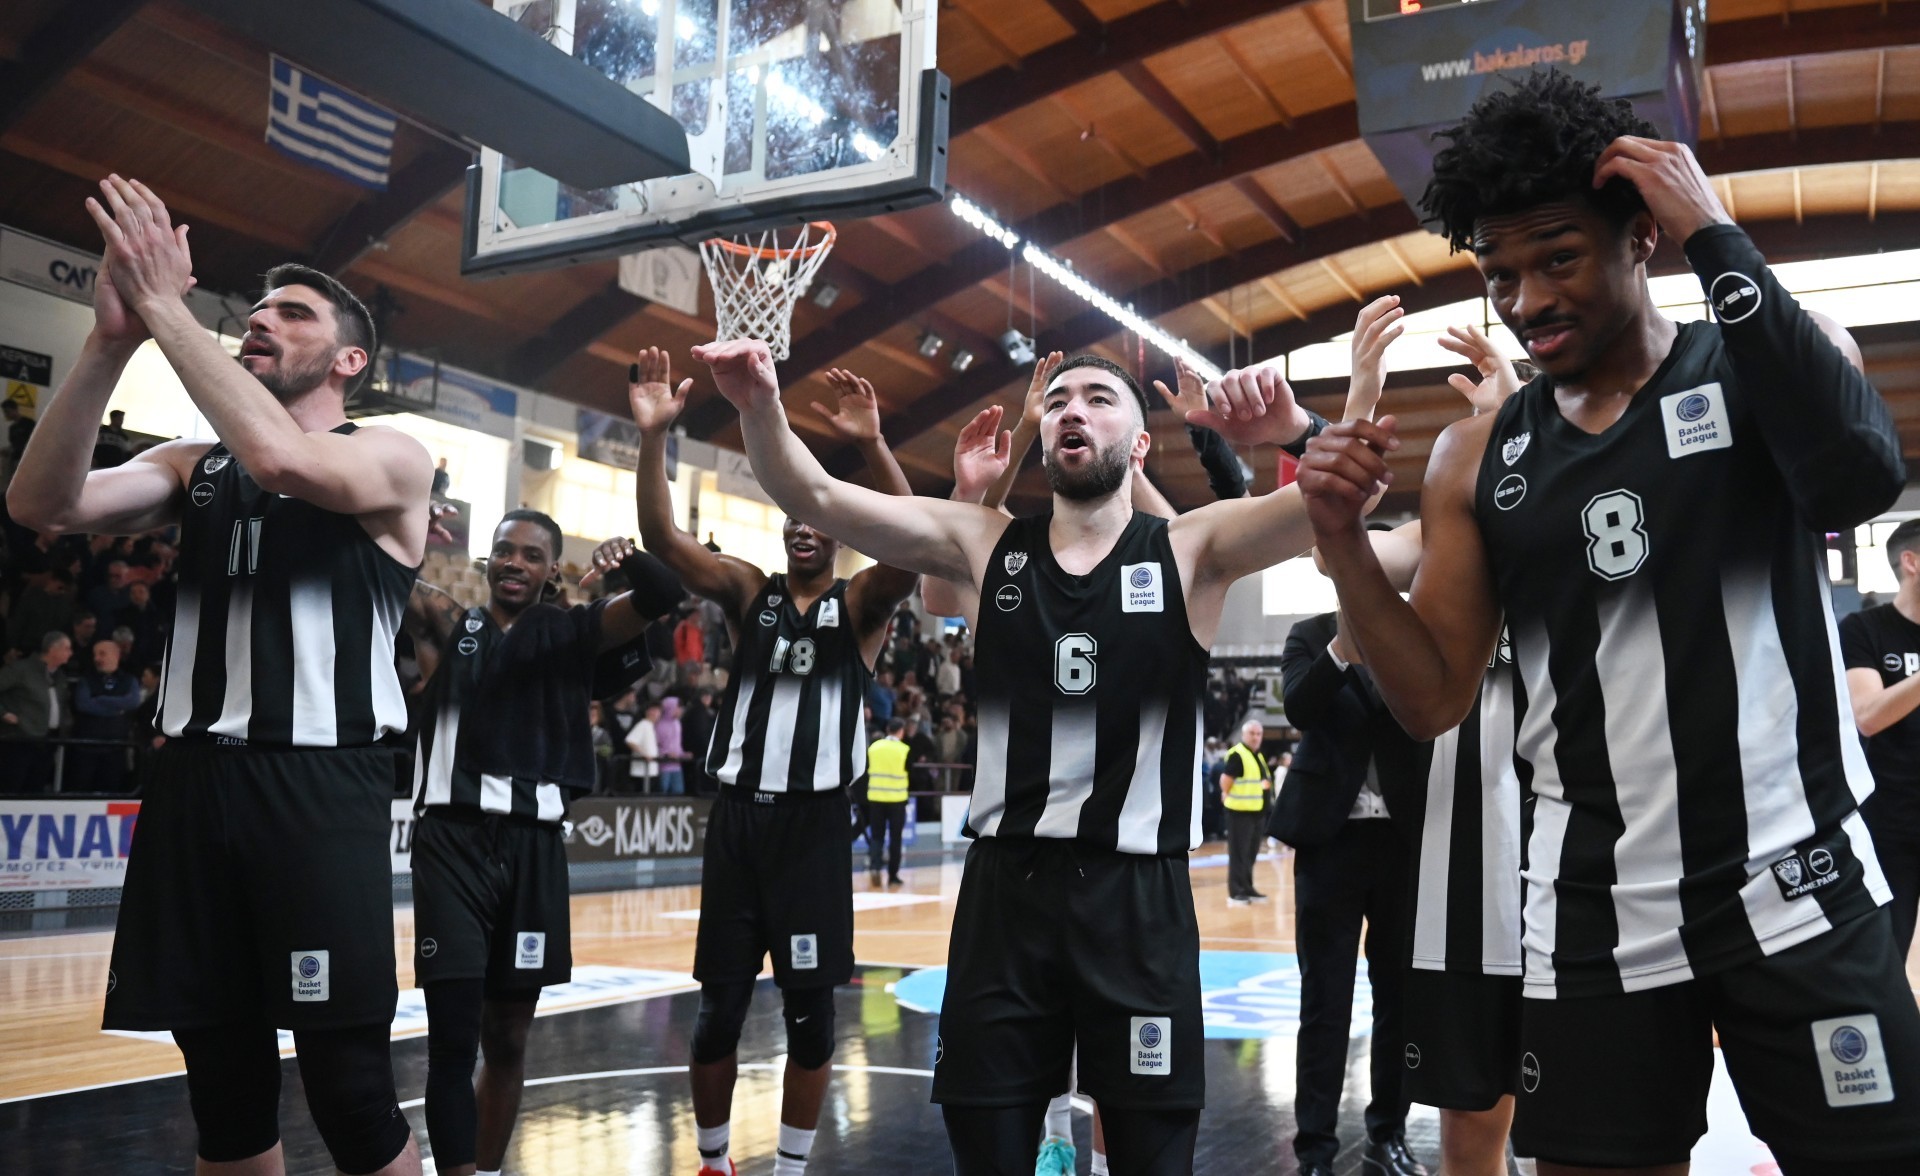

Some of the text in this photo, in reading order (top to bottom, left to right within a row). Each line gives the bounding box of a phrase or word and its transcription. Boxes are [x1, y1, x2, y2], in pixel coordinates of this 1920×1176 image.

[1422, 39, 1588, 82] www.bakalaros.gr
[1679, 420, 1717, 438] Basket
[1680, 431, 1718, 446] League
[1497, 484, 1525, 498] GSA
[1581, 488, 1649, 581] 8
[1129, 591, 1155, 599] Basket
[1130, 599, 1156, 607] League
[769, 635, 816, 676] 18
[1054, 632, 1097, 695] 6
[614, 805, 695, 857] KAMISIS
[298, 988, 321, 996] League
[1137, 1051, 1162, 1059] Basket
[1137, 1059, 1163, 1068] League
[1834, 1068, 1876, 1082] Basket
[1837, 1080, 1878, 1095] League
